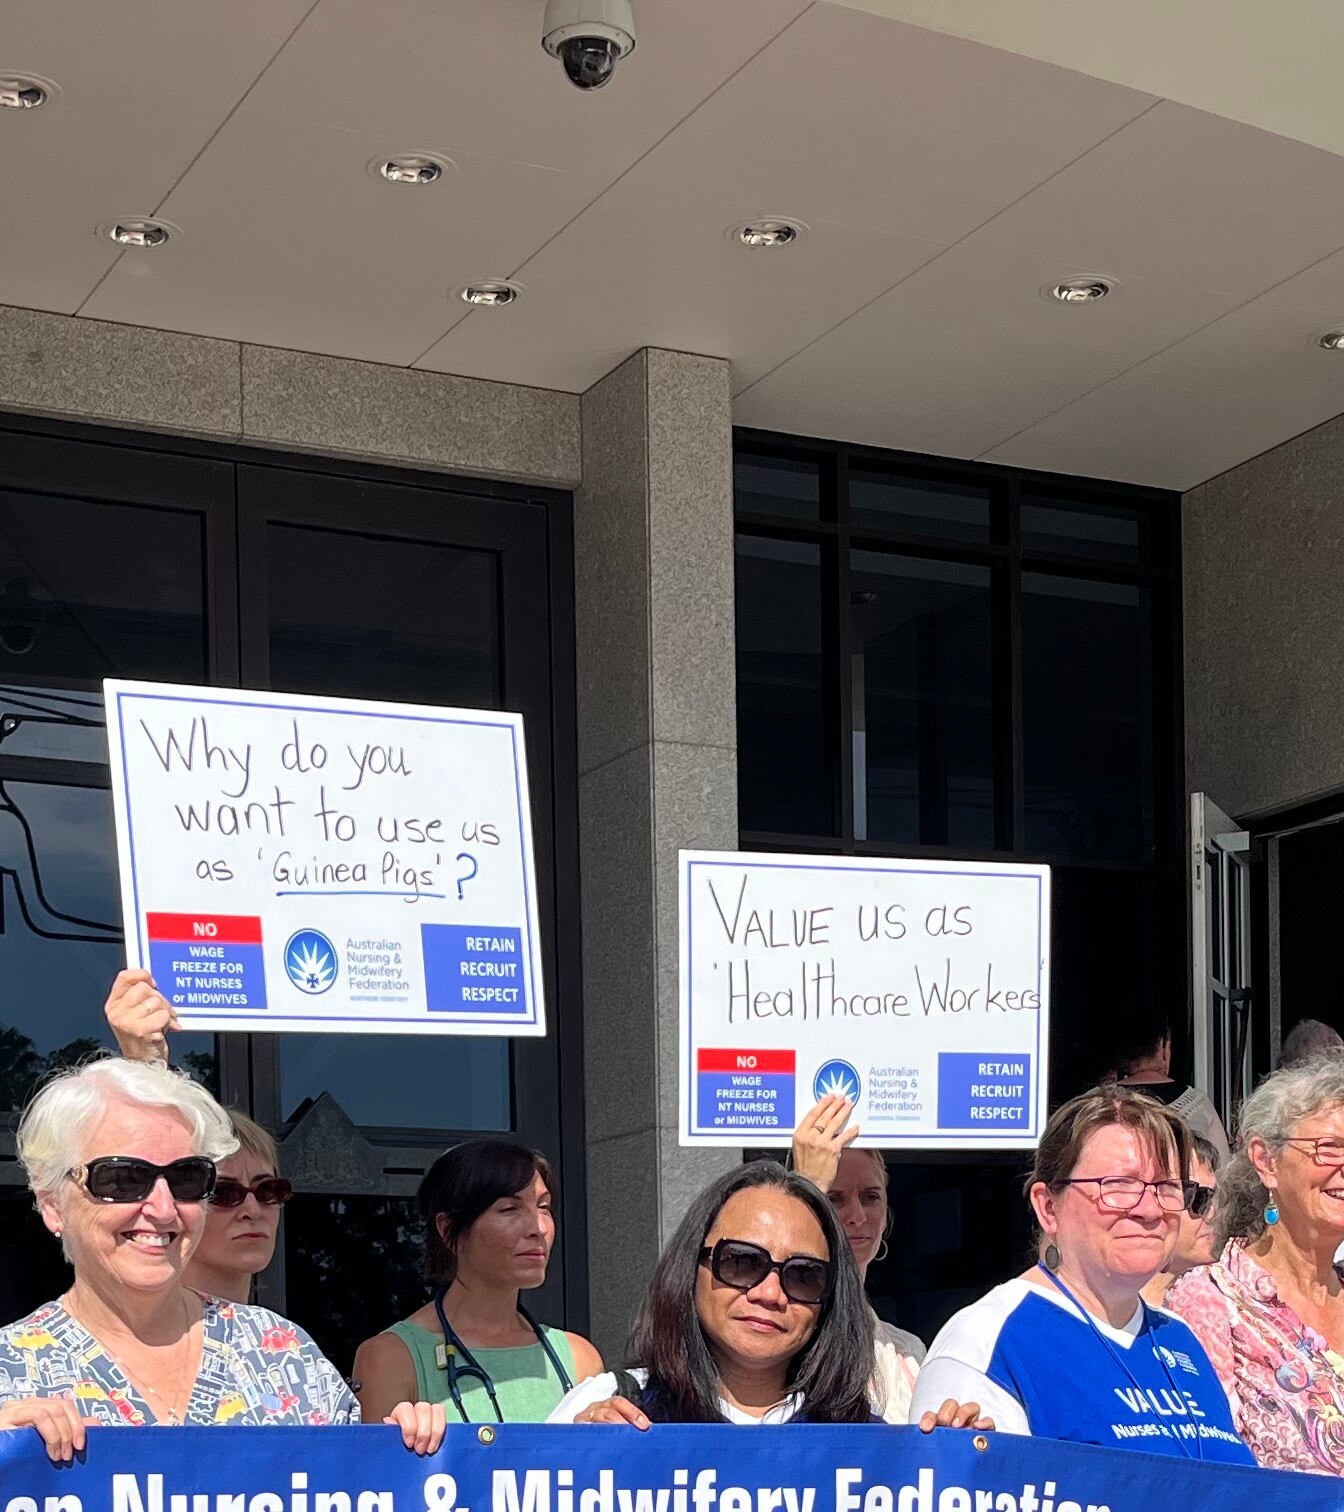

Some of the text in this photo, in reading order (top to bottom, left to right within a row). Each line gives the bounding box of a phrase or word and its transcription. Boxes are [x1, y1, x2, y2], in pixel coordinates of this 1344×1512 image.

[140, 716, 412, 797] Why do you
[175, 785, 501, 846] want to use us
[196, 859, 234, 881] as
[708, 874, 973, 948] VALUE us as
[192, 922, 218, 937] NO
[346, 938, 402, 951] Australian
[465, 936, 515, 952] RETAIN
[189, 946, 225, 958] WAGE
[346, 952, 402, 966] Nursing &
[172, 961, 243, 974] FREEZE FOR
[347, 965, 403, 979] Midwifery
[459, 961, 517, 977] RECRUIT
[176, 977, 243, 989] NT NURSES
[349, 977, 410, 990] Federation
[173, 993, 248, 1005] or MIDWIVES
[461, 986, 519, 1002] RESPECT
[736, 1056, 757, 1068] NO
[868, 1066, 919, 1077] Australian
[978, 1063, 1024, 1076] RETAIN
[731, 1076, 762, 1086] WAGE
[868, 1078, 918, 1089] Nursing &
[716, 1089, 777, 1099] FREEZE FOR
[868, 1089, 917, 1101] Midwifery
[971, 1085, 1024, 1098] RECRUIT
[718, 1103, 775, 1112] NT NURSES
[970, 1107, 1023, 1120] RESPECT
[714, 1116, 778, 1126] or MIDWIVES
[1114, 1388, 1206, 1417] VALUE
[1111, 1424, 1161, 1439] Nurses
